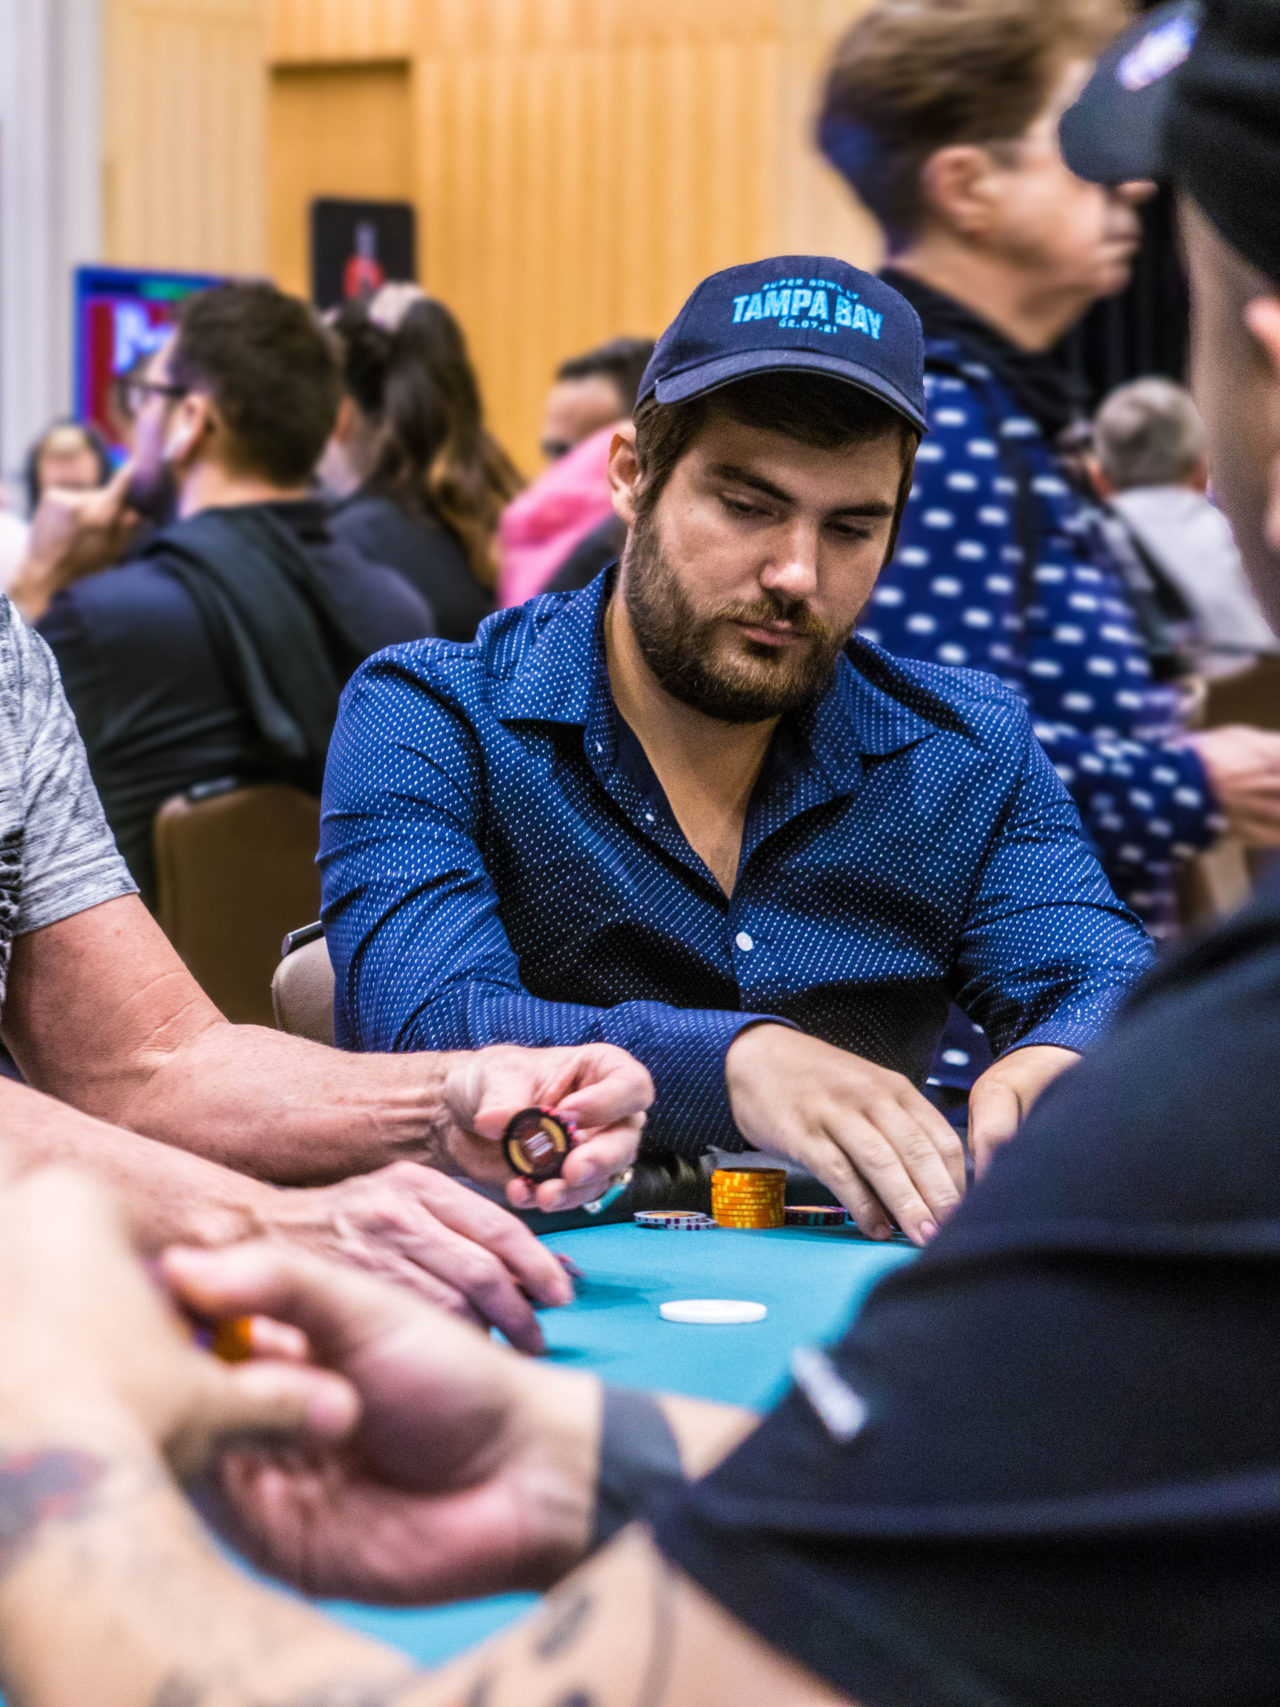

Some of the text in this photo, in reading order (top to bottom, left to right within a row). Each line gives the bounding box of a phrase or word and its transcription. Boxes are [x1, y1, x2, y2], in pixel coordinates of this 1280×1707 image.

[762, 278, 804, 292] SUPER
[809, 278, 844, 293] BOWL
[732, 288, 883, 340] TAMPA BAY
[778, 316, 838, 334] 02.07.21
